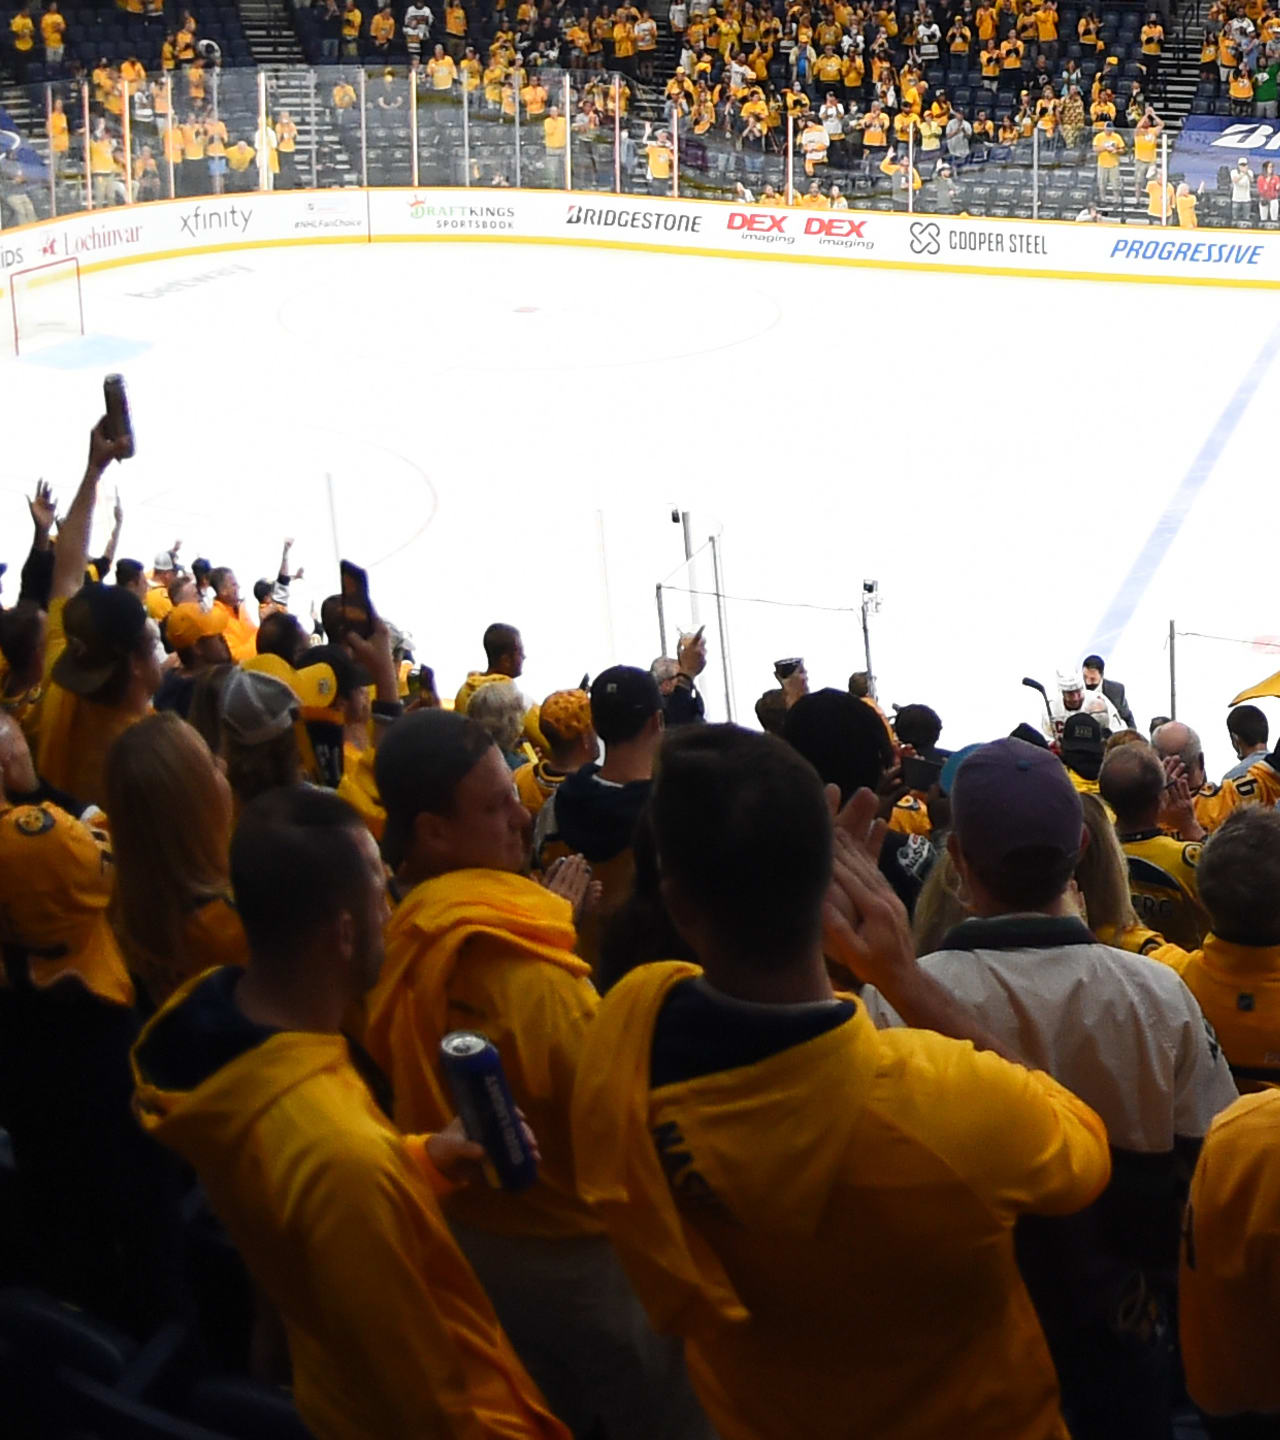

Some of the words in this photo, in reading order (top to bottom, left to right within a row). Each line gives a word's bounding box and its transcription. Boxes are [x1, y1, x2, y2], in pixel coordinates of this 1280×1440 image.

[180, 205, 254, 237] xfinity
[409, 203, 515, 220] DRAFTKINGS
[566, 205, 703, 234] BRIDGESTONE
[436, 219, 514, 230] SPORTSBOOK
[727, 212, 789, 234] DEX
[804, 217, 869, 239] DEX
[63, 224, 144, 257] Lochinvar
[741, 231, 796, 246] imaging
[818, 238, 875, 251] imaging
[949, 230, 1005, 253] COOPER
[1009, 234, 1049, 256] STEEL
[1110, 239, 1264, 265] PROGRESSIVE
